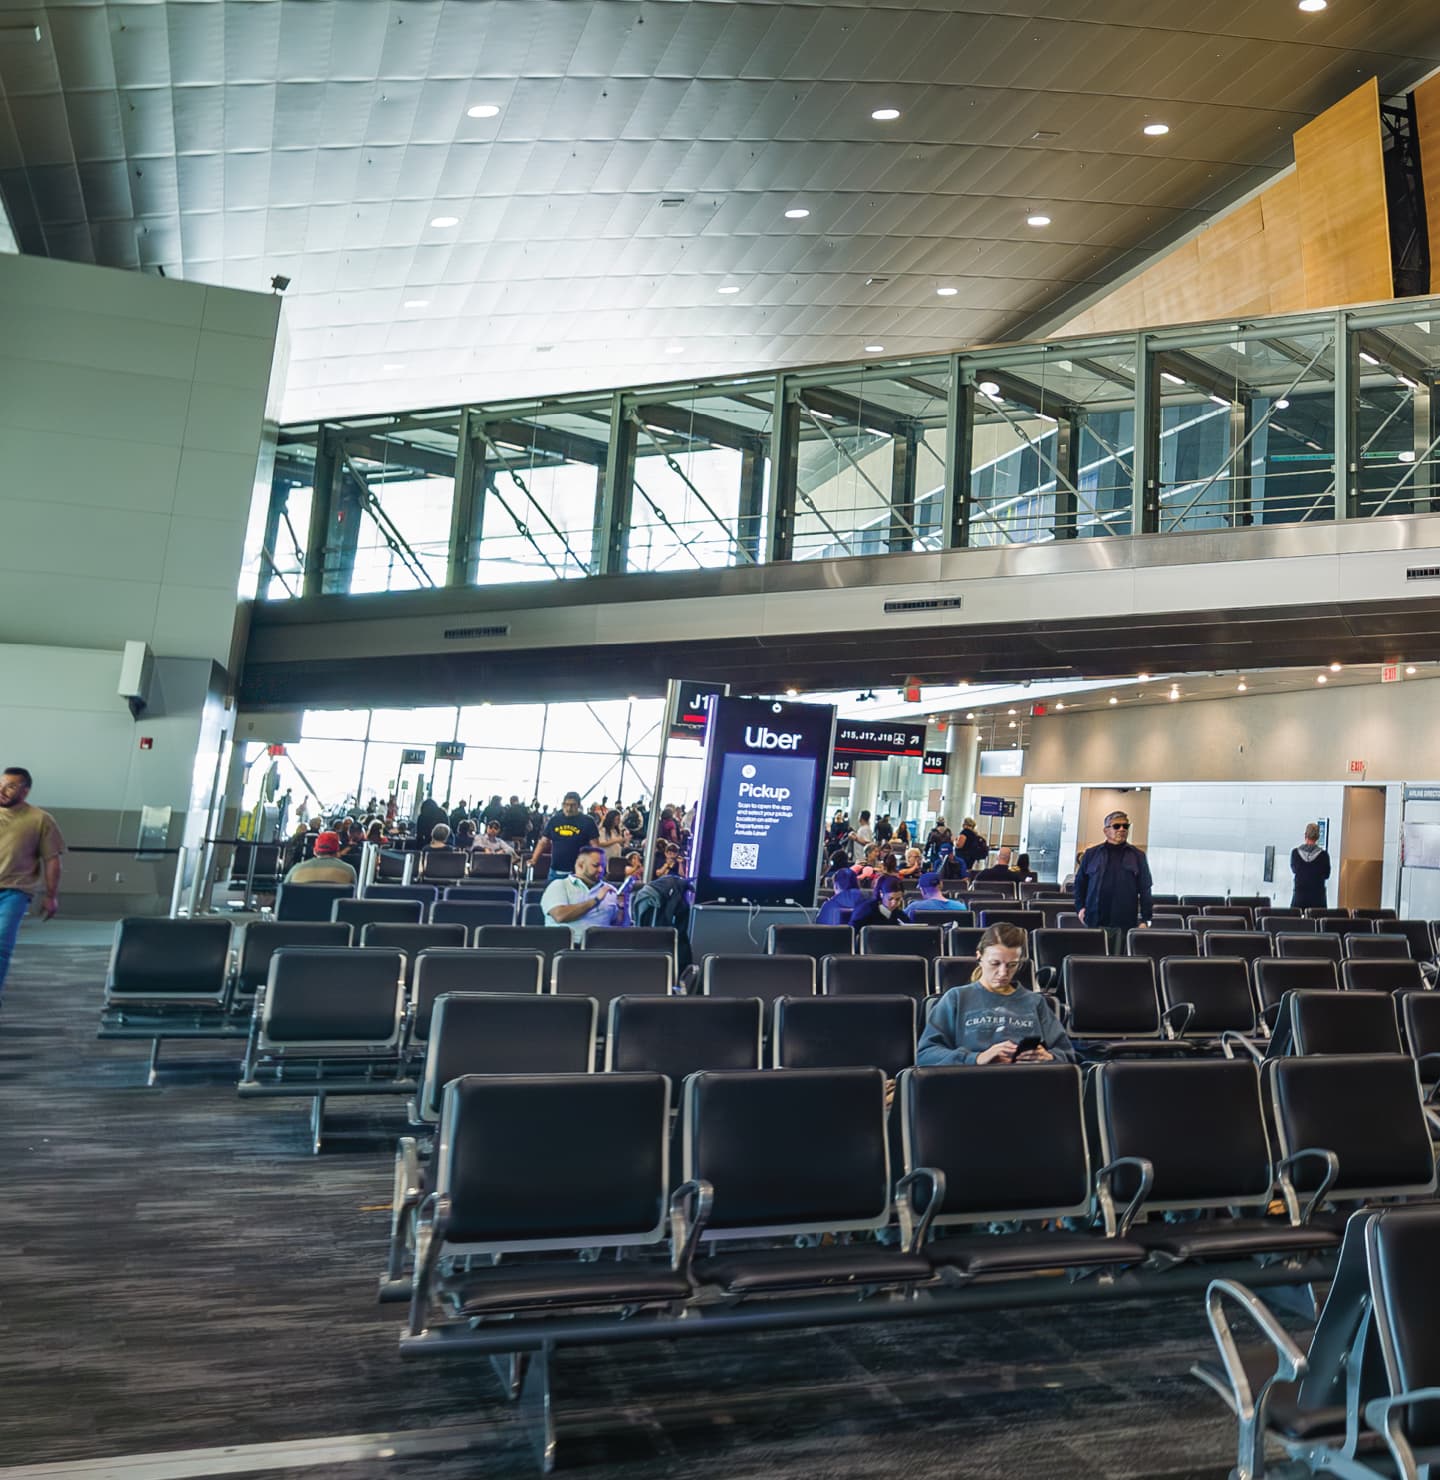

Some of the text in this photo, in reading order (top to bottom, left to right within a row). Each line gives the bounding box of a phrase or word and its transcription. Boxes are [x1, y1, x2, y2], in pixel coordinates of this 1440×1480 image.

[744, 726, 803, 750] Uber
[833, 762, 850, 770] J17
[924, 757, 942, 767] J15
[739, 782, 790, 802] Pickup
[964, 1016, 1034, 1028] CRATER LAKE
